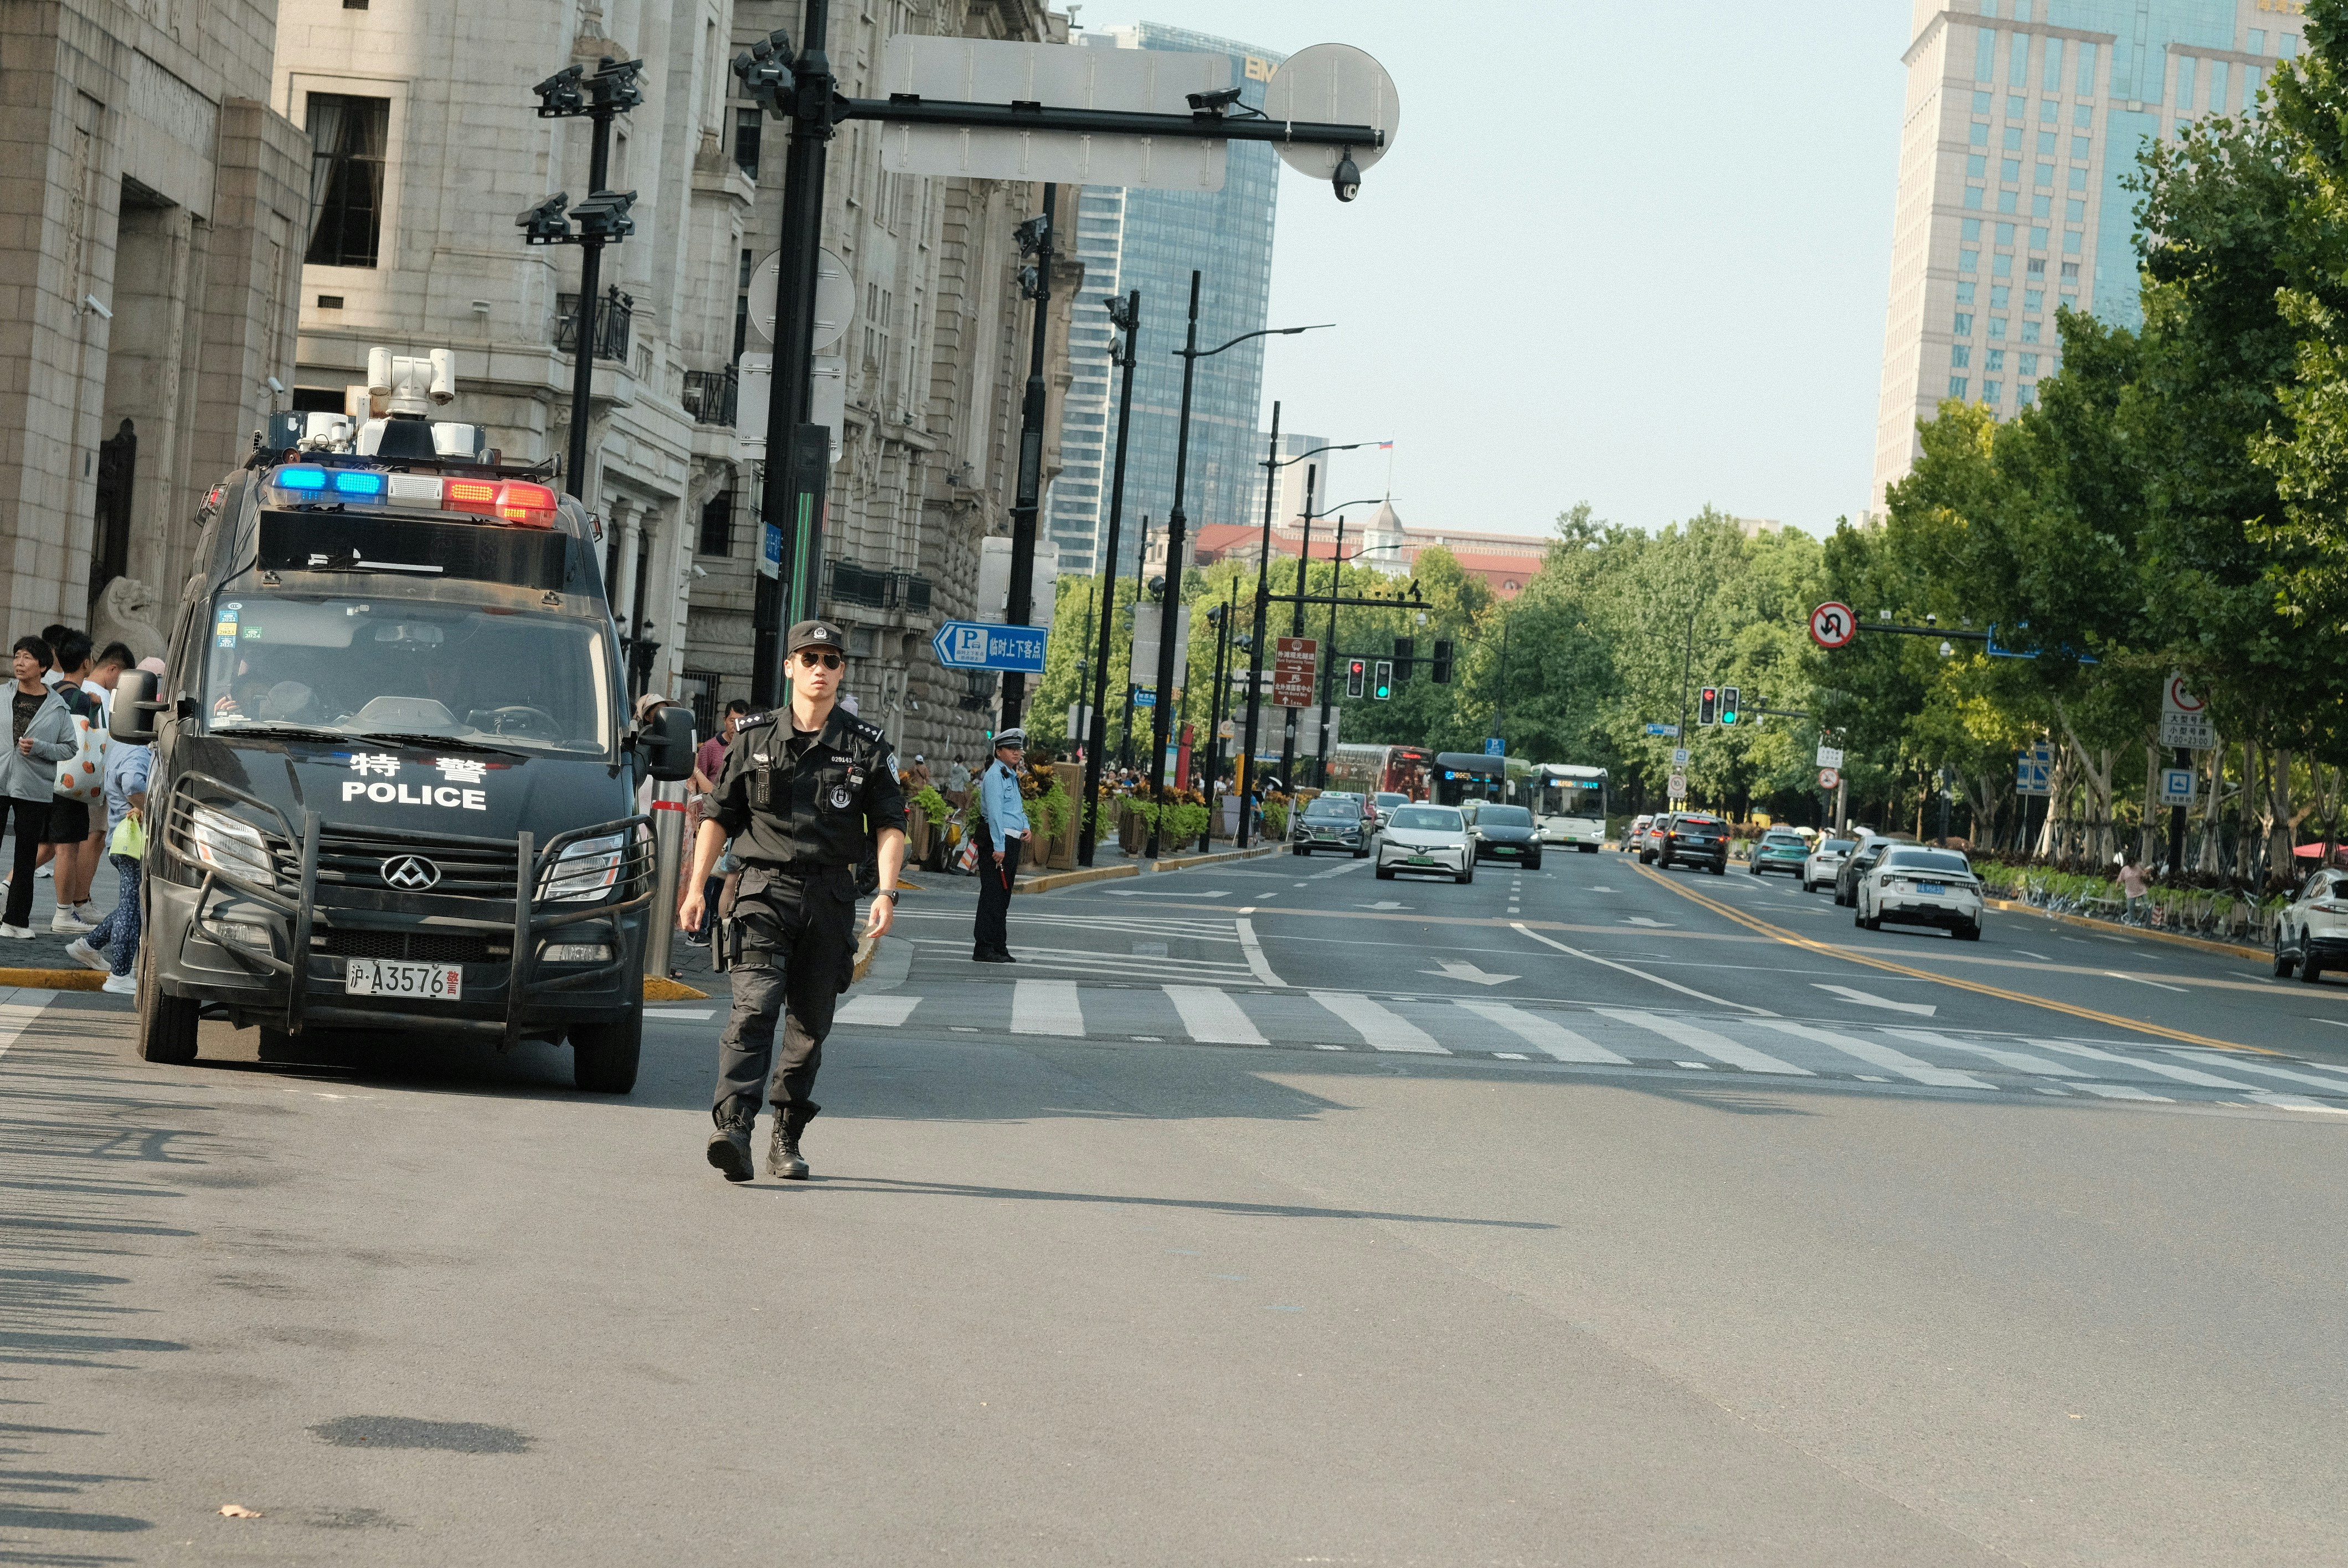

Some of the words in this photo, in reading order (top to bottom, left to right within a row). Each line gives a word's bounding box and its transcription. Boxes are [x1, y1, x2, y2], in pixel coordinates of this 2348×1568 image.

[961, 630, 978, 649] P
[990, 638, 1041, 658] 临时上下客点
[2170, 726, 2206, 736] 小型号牌
[342, 781, 487, 811] POLICE
